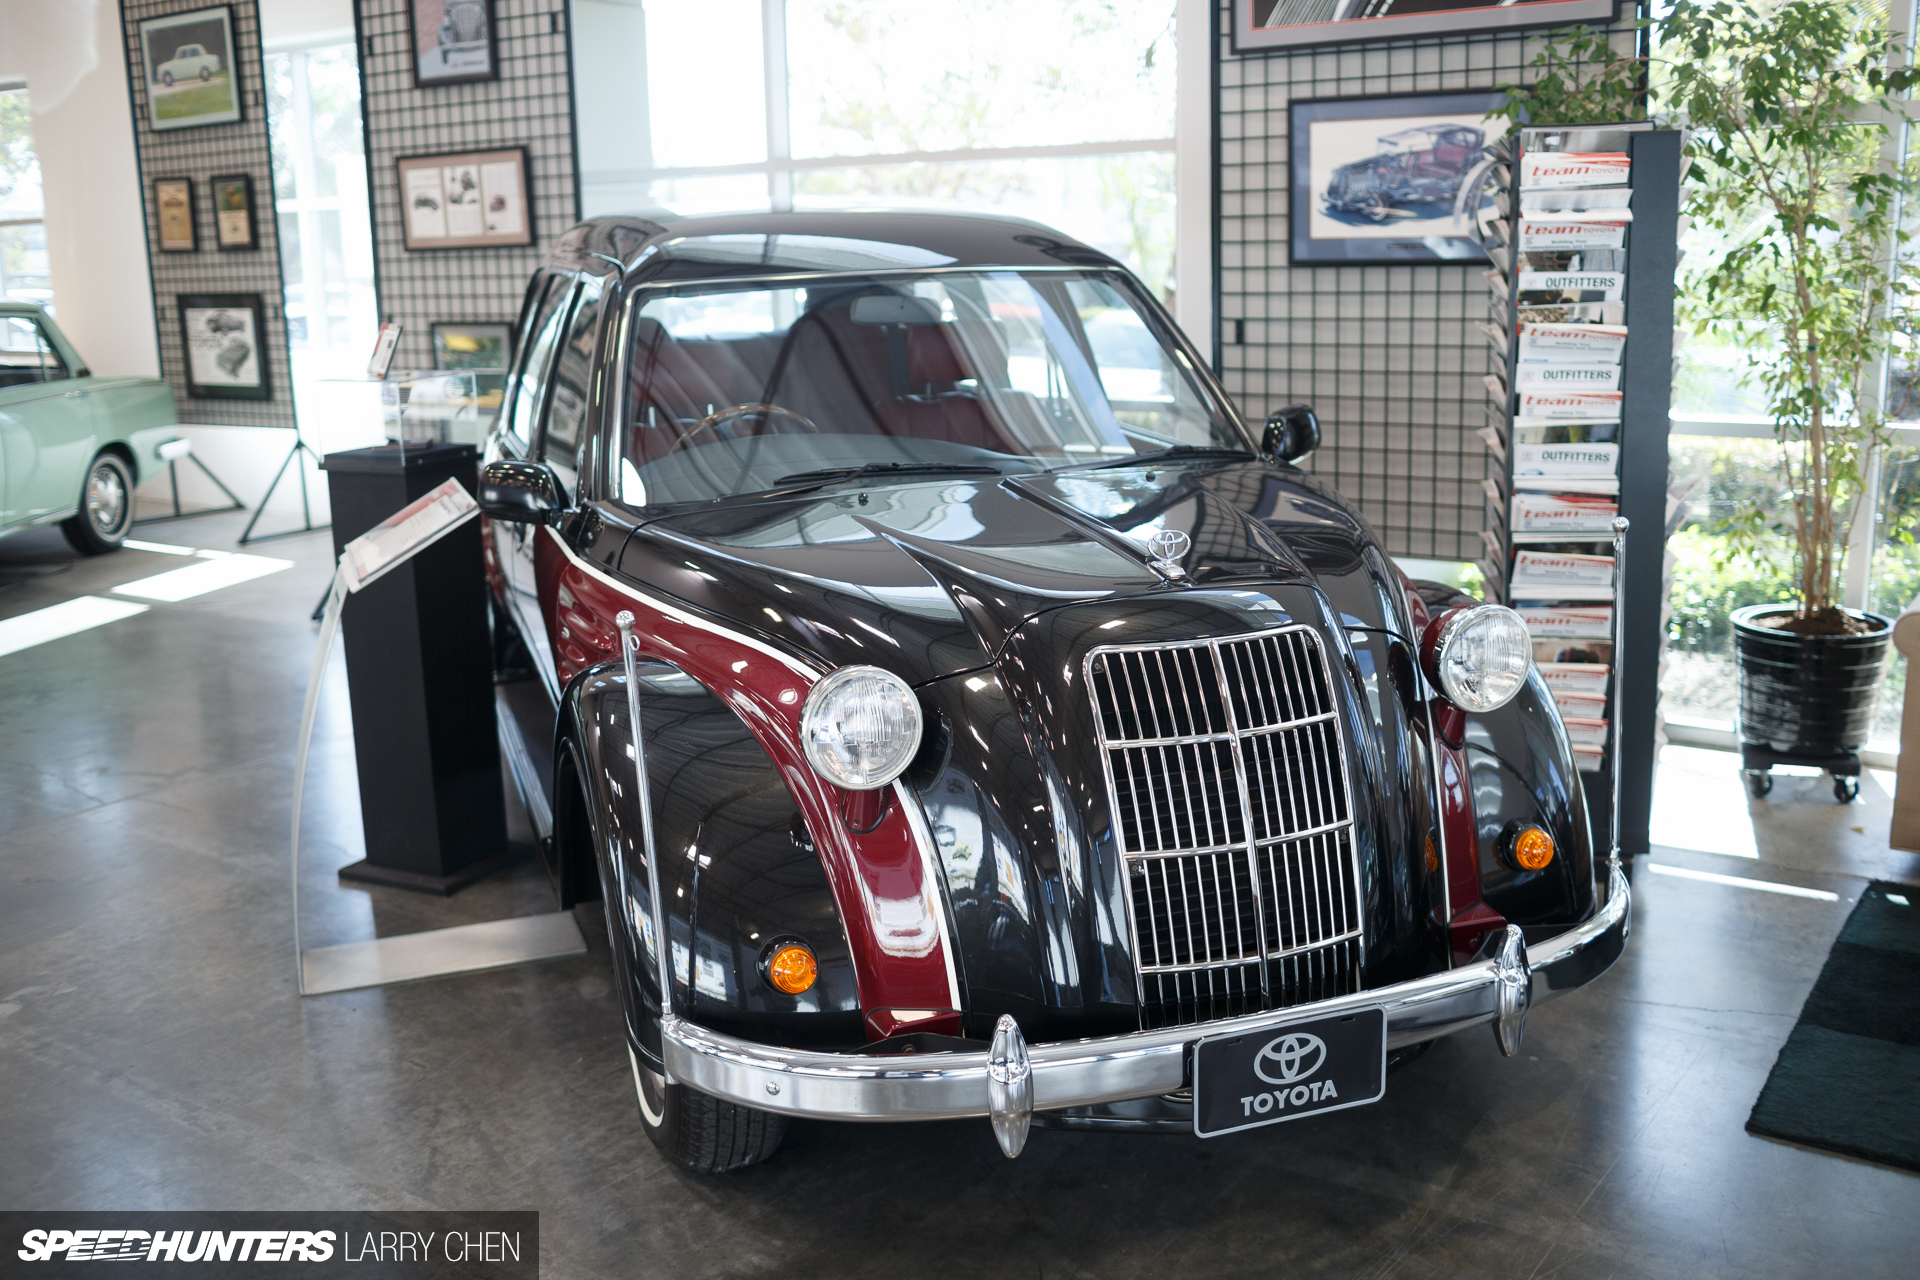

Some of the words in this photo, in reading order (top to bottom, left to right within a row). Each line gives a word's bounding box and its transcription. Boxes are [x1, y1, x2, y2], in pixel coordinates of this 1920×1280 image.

[1532, 166, 1590, 177] team
[1524, 224, 1582, 235] team
[1545, 277, 1615, 288] OUTFITTERS
[1530, 328, 1587, 339] team
[1543, 370, 1612, 380] OUTFITTERS
[1526, 395, 1582, 405] team
[1541, 450, 1610, 463] OUTFITTERS
[1523, 509, 1580, 518] team
[1519, 555, 1575, 567] team
[1526, 616, 1571, 626] eam
[1241, 1079, 1338, 1117] TOYOTA
